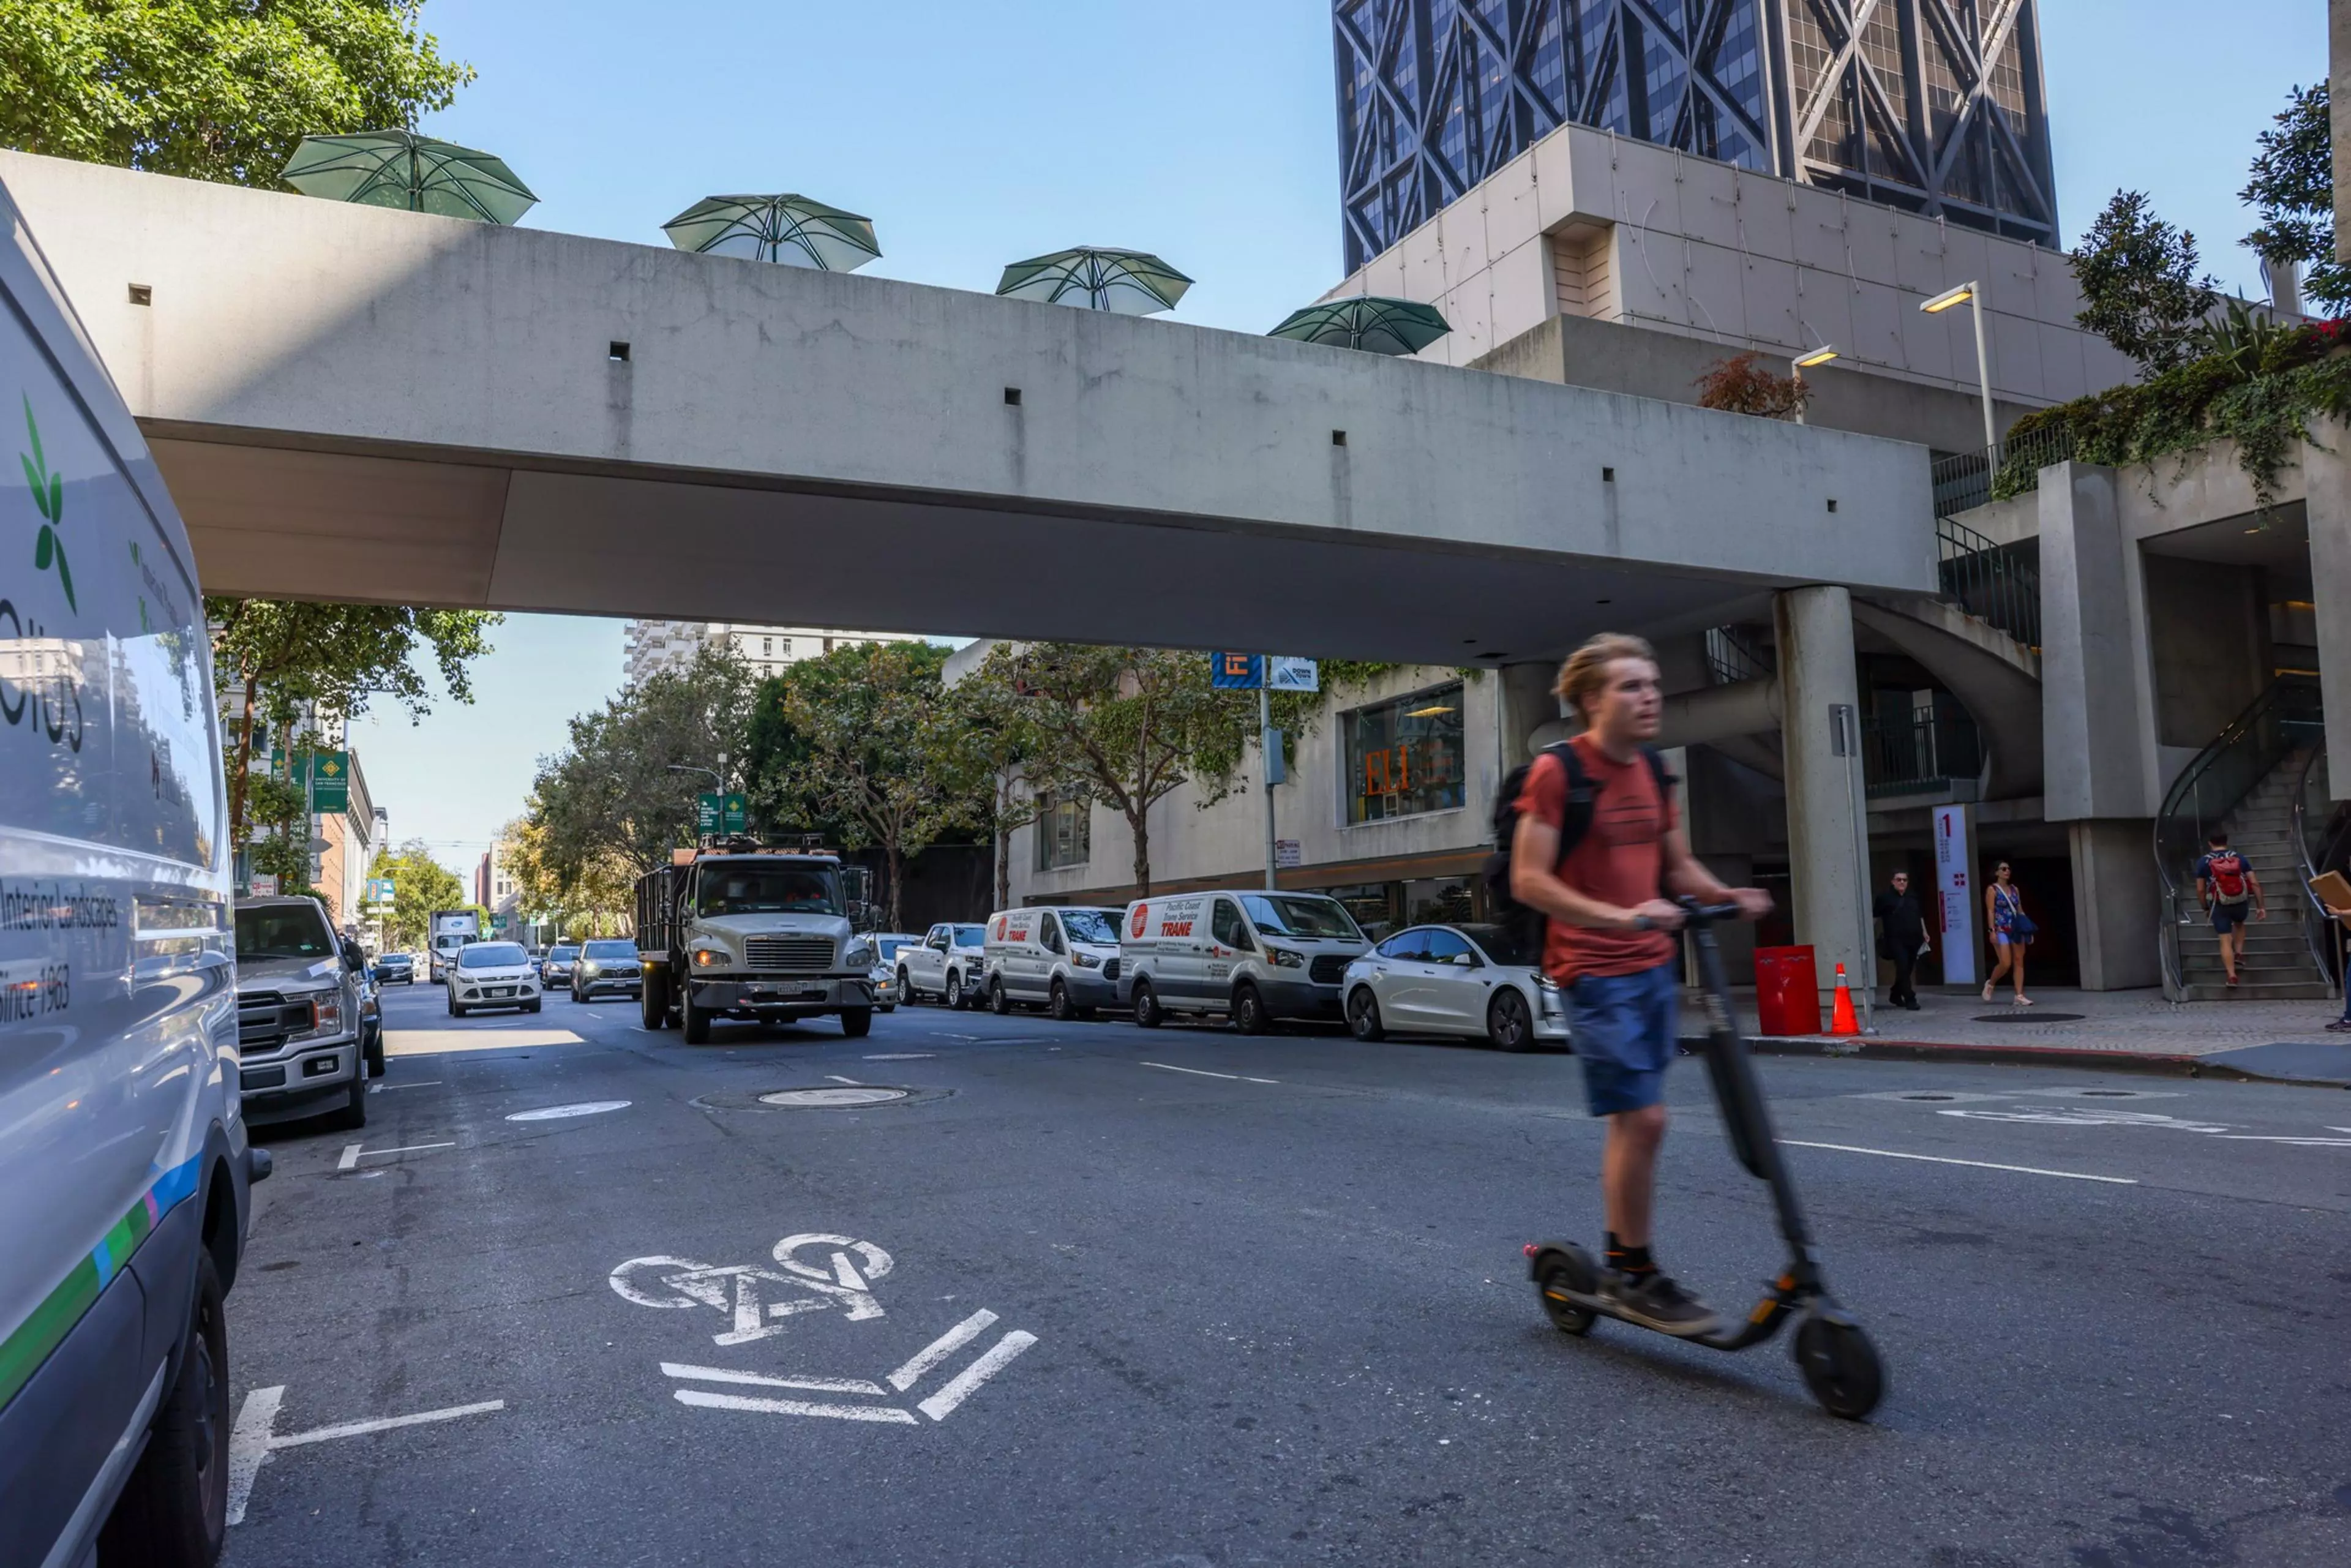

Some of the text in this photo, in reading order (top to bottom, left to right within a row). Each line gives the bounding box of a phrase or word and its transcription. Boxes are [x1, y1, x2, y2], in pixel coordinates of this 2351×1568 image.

[1943, 813, 1951, 838] 1
[0, 878, 118, 939] Interior Landscapes
[1166, 901, 1201, 911] Pacific Coast
[1178, 912, 1198, 920] Service
[1009, 930, 1027, 941] TRANE
[1161, 921, 1193, 936] TRANE
[40, 964, 69, 1015] 1963
